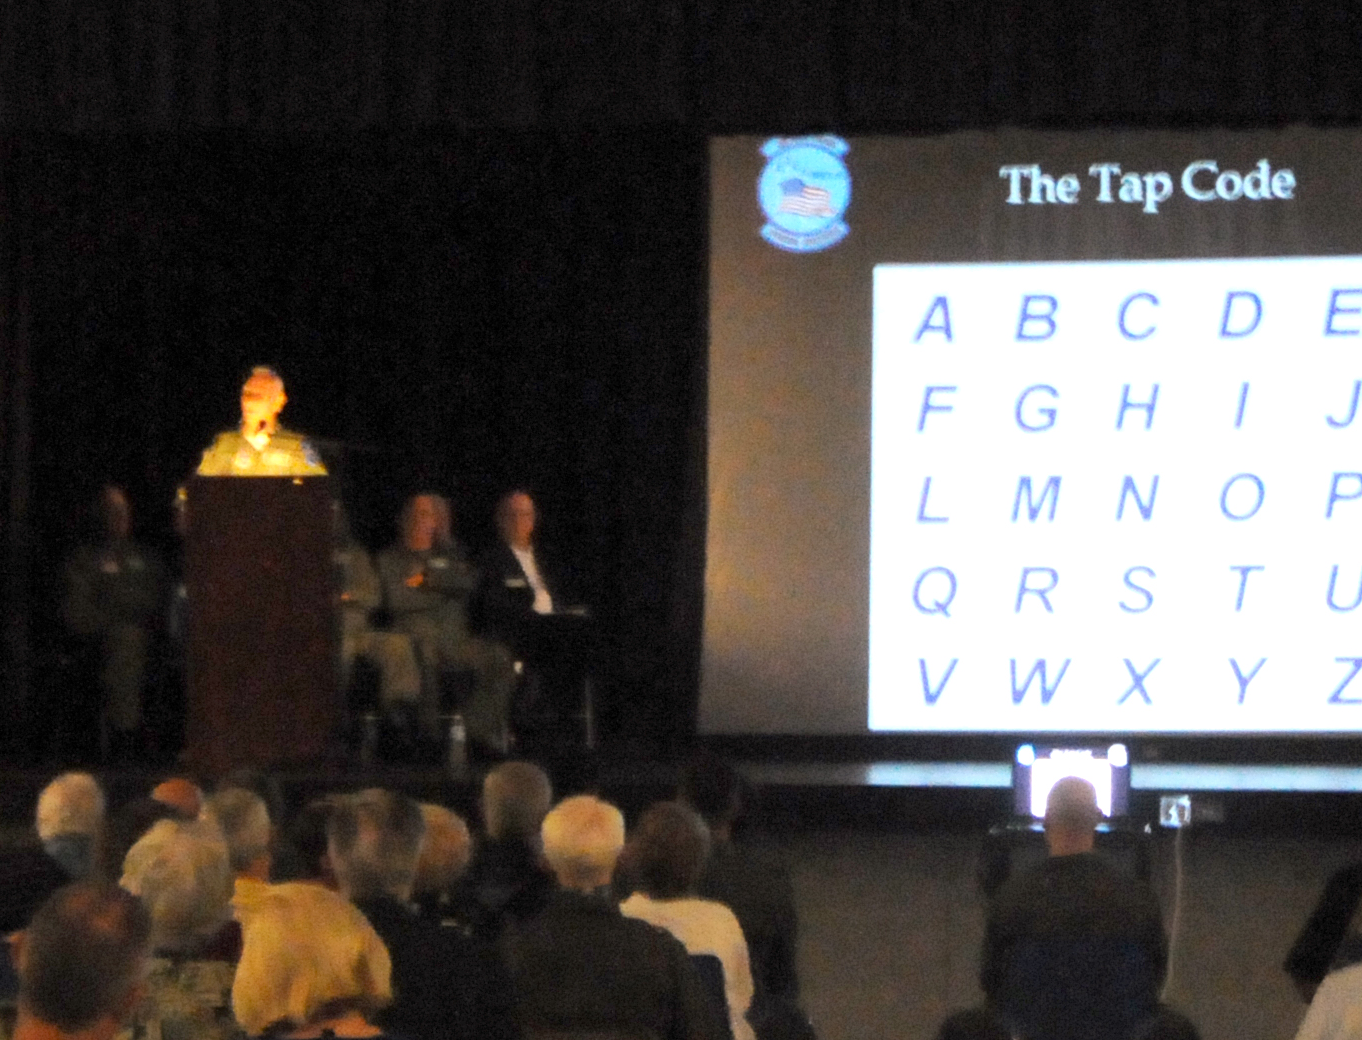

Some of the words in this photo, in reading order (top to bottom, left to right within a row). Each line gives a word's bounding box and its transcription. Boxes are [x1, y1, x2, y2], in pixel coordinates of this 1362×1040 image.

[998, 163, 1081, 205] The
[1088, 162, 1174, 214] Tap
[1180, 158, 1297, 201] Code
[914, 295, 954, 343] A
[1015, 294, 1059, 342] B
[1117, 291, 1160, 341] C
[1219, 290, 1263, 339] D
[917, 386, 957, 432] F
[1015, 384, 1059, 432] G
[1116, 384, 1159, 430] H
[1326, 380, 1362, 428] J
[917, 477, 948, 523] L
[1011, 476, 1062, 522] M
[1116, 475, 1159, 520] N
[1220, 473, 1265, 521] O
[912, 566, 957, 617] Q
[1015, 567, 1059, 612] R
[1119, 566, 1155, 613] S
[1230, 565, 1264, 610] T
[919, 658, 958, 706] V
[1010, 658, 1071, 705] W
[1118, 659, 1160, 704] X
[1230, 658, 1266, 704] Y
